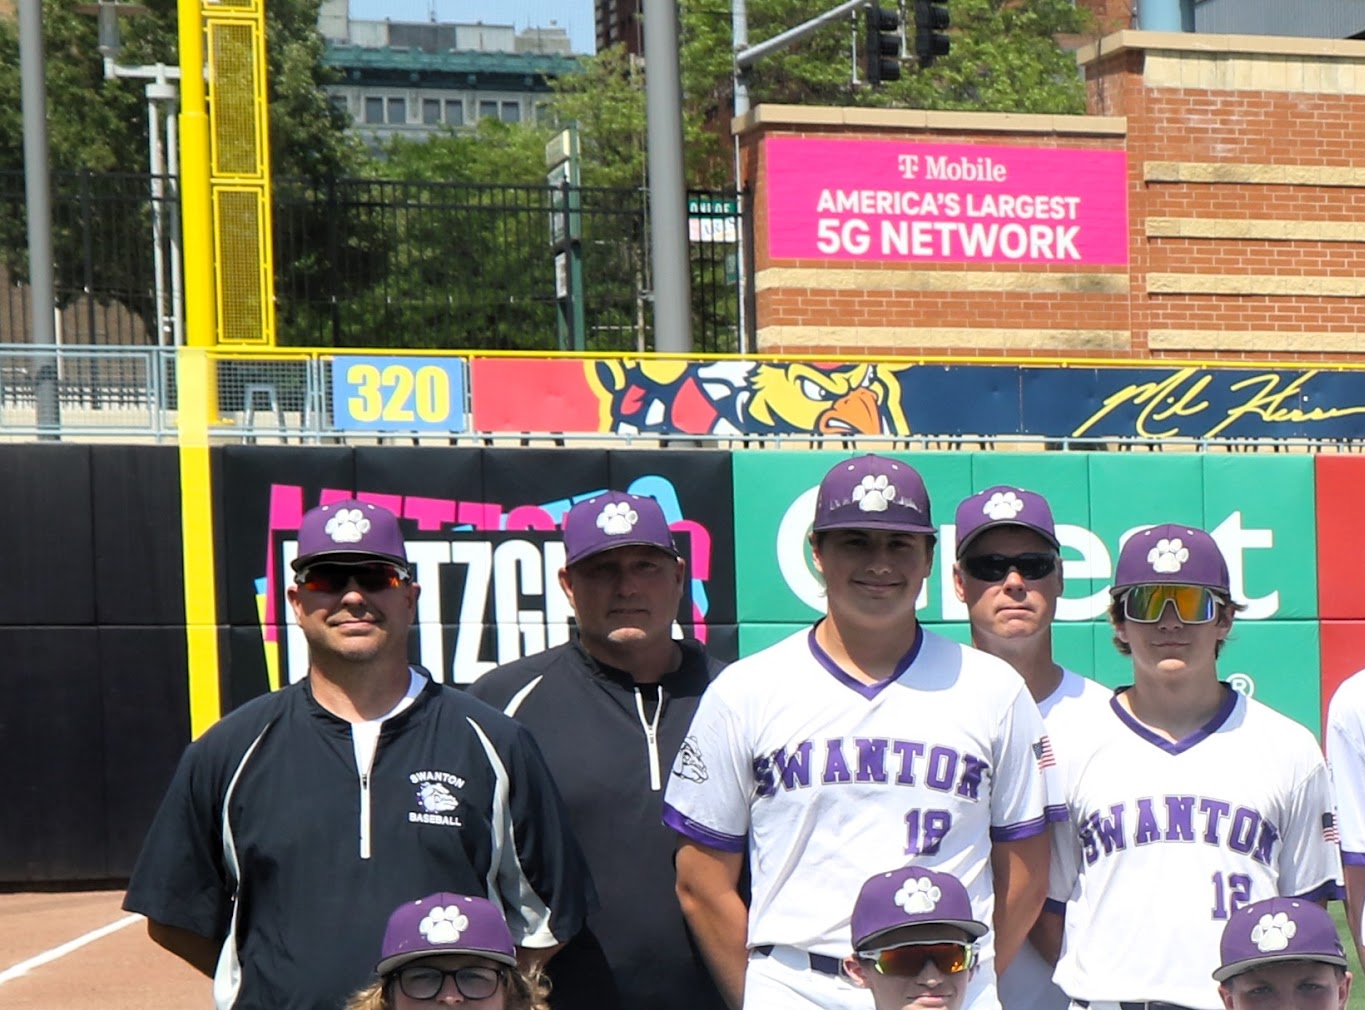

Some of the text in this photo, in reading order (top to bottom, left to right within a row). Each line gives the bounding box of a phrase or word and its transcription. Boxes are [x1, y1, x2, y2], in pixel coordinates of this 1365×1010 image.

[925, 155, 1007, 182] Mobile
[817, 189, 1081, 220] AMERICA'S LARGEST
[816, 218, 1082, 260] 5G NETWORK
[346, 364, 451, 423] 320
[409, 771, 465, 788] SWANTON
[752, 736, 992, 801] SWANTON
[408, 812, 462, 826] BASEBALL
[903, 808, 951, 856] 18
[1079, 794, 1284, 867] SWANTON
[1211, 870, 1254, 922] 12
